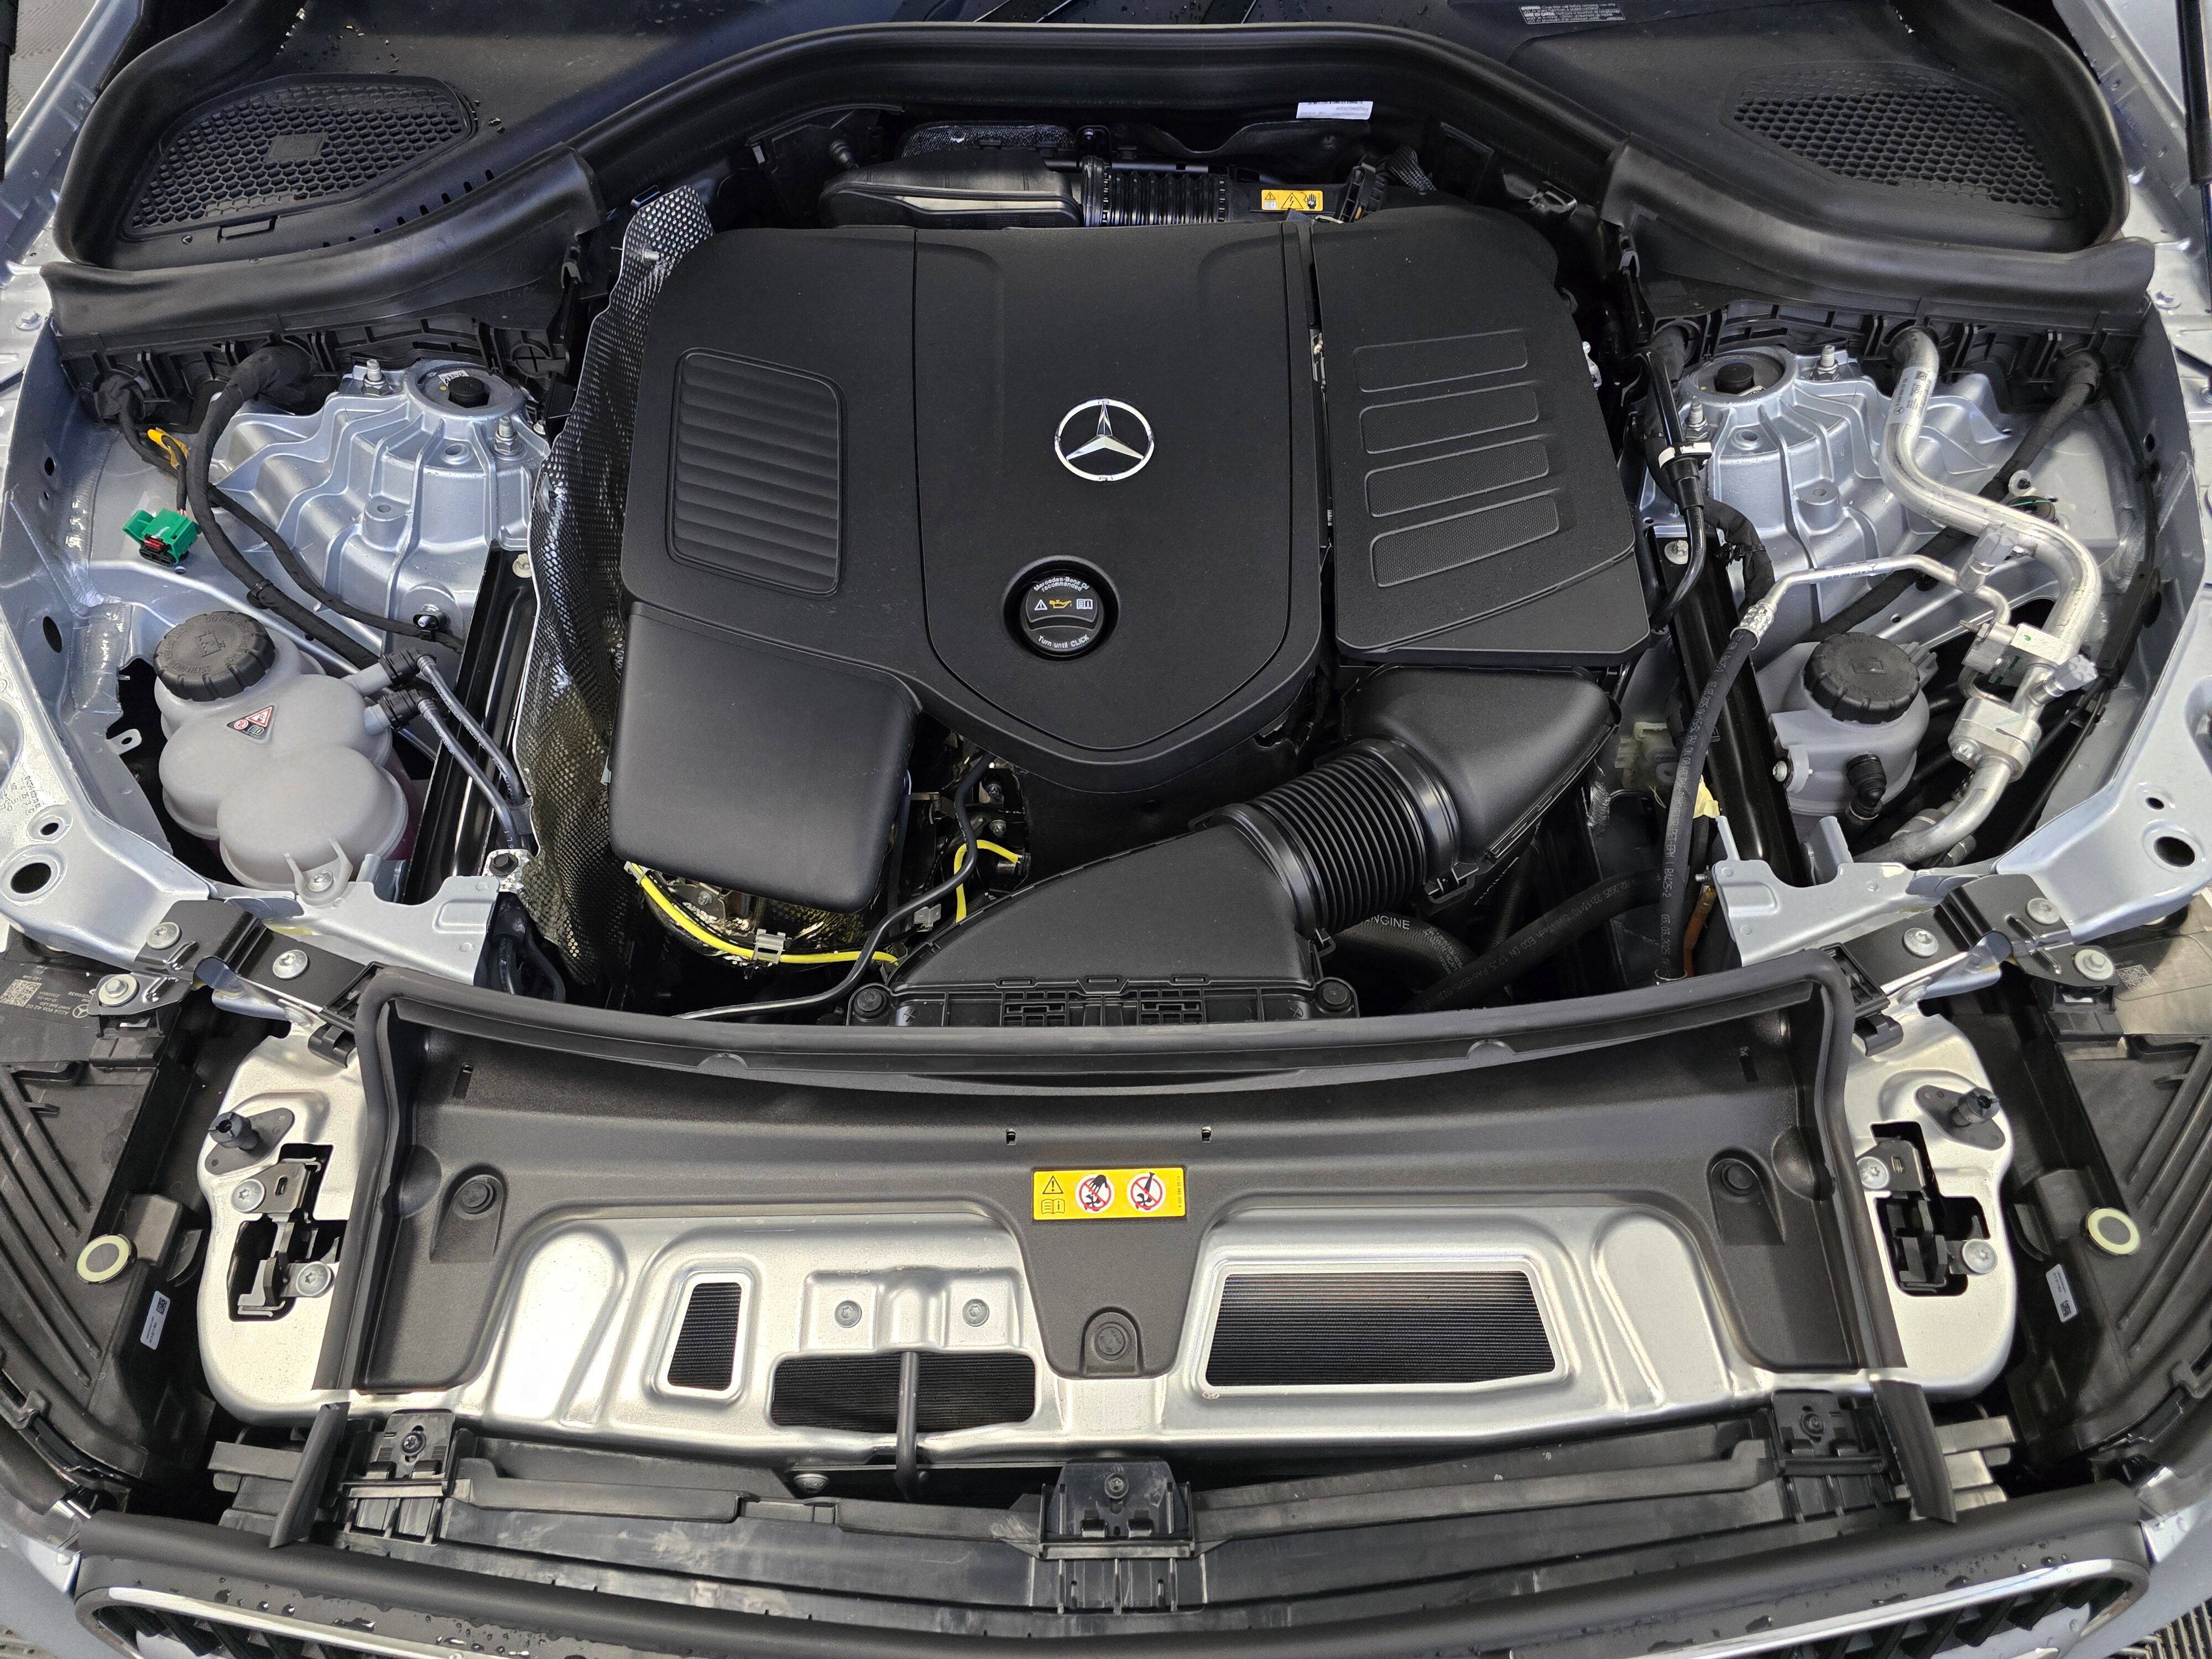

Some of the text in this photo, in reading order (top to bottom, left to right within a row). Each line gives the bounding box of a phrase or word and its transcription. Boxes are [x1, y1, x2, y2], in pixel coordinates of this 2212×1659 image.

[1041, 582, 1082, 592] recommended
[1038, 635, 1052, 647] Turn
[1071, 634, 1090, 647] CLICK
